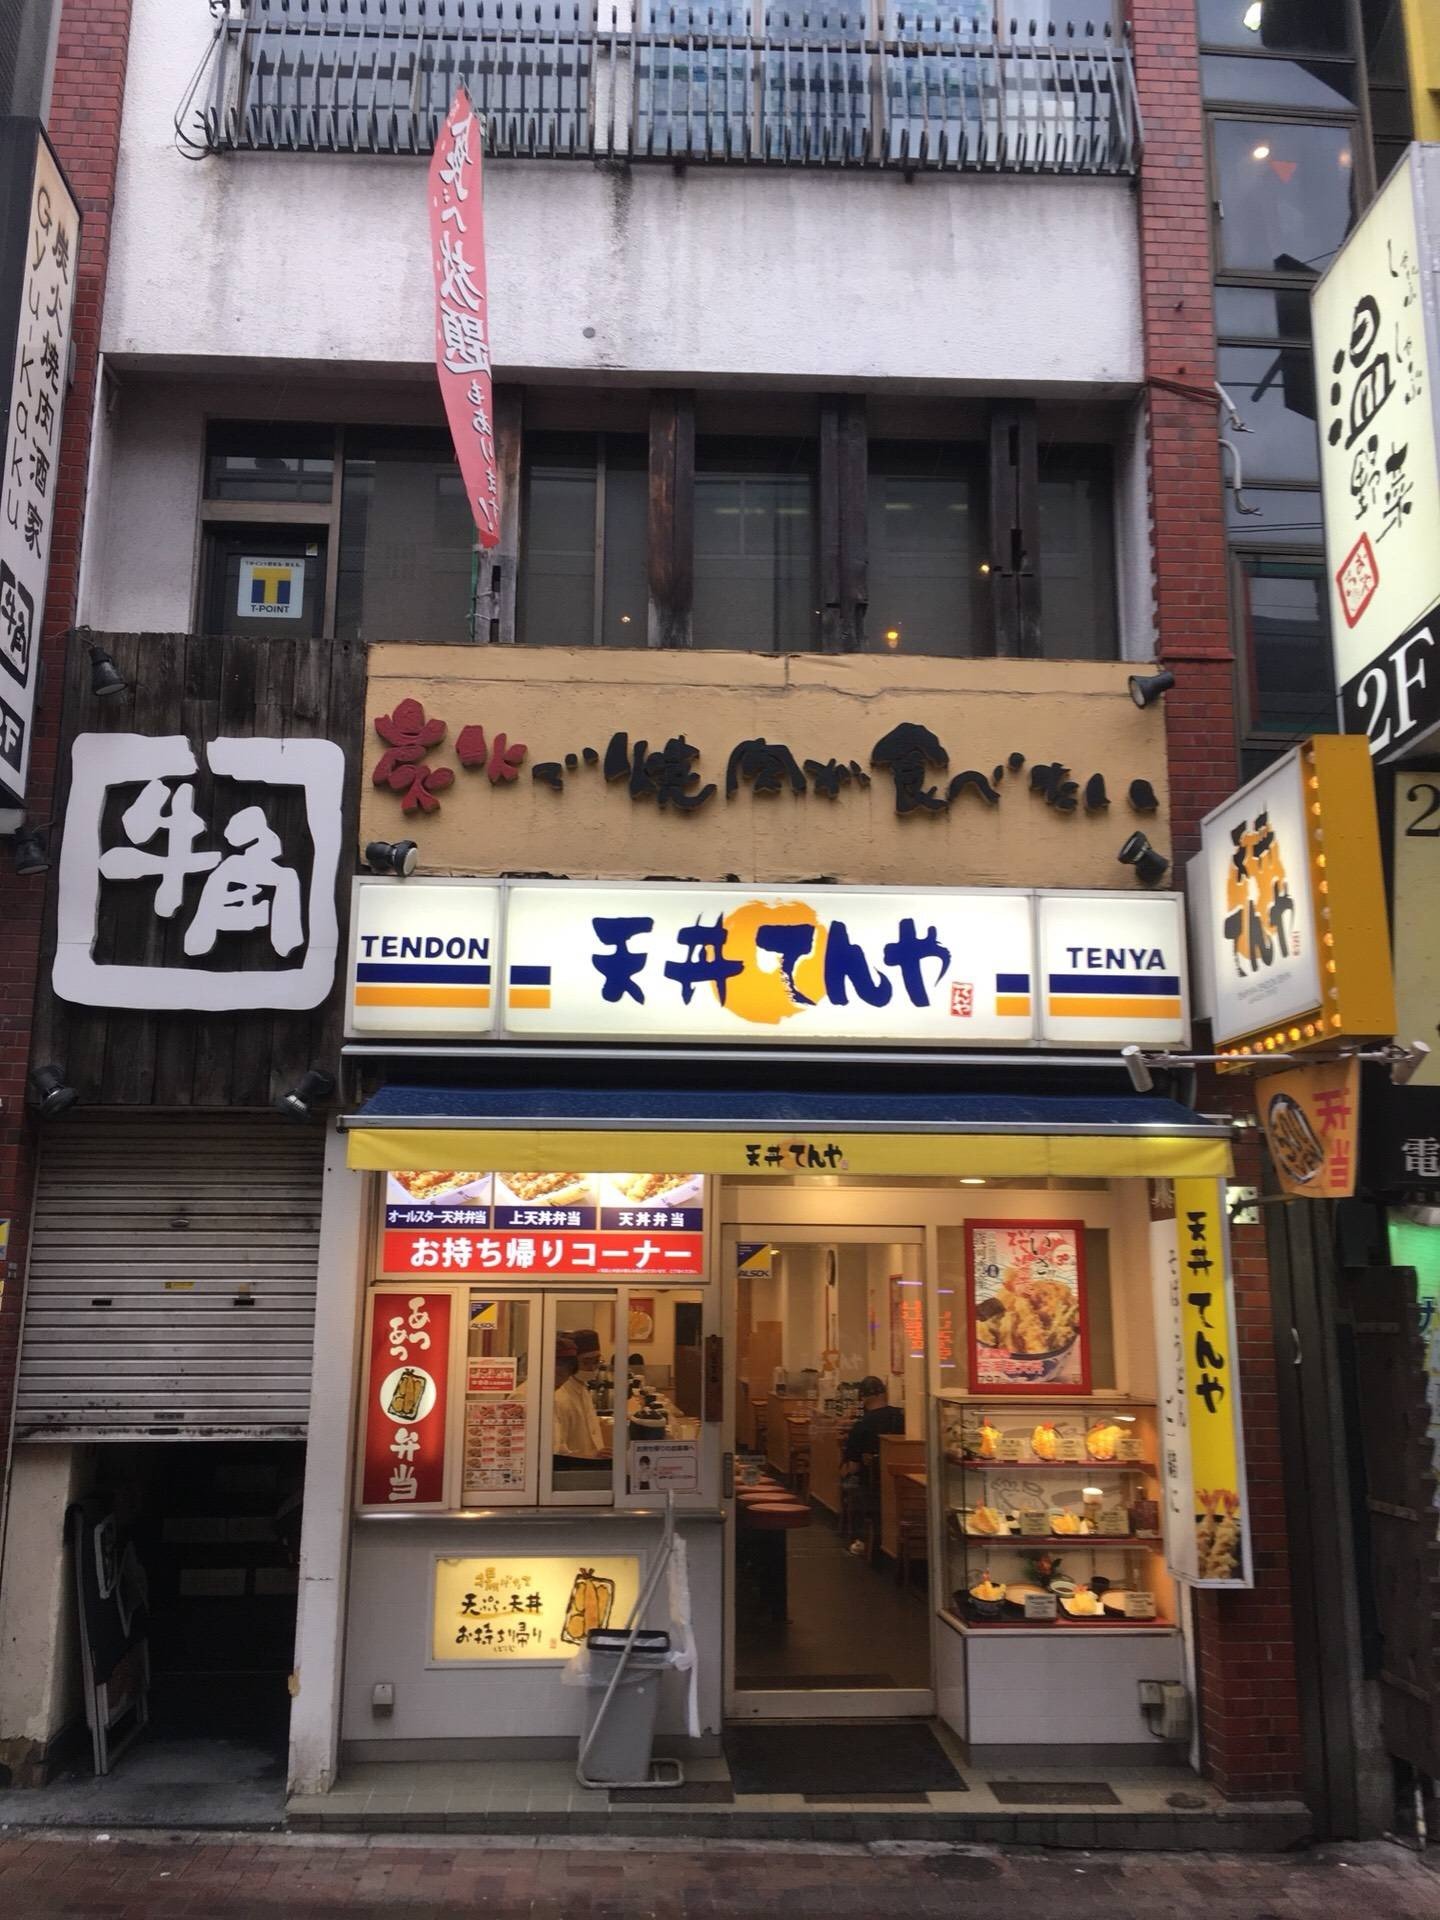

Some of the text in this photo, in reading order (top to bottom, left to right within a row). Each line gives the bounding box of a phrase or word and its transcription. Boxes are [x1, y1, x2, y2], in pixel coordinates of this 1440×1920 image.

[1329, 294, 1413, 544] 温野菜
[251, 604, 289, 613] T-POINT
[1357, 628, 1433, 752] 2F
[373, 697, 1159, 816] 炭火で焼肉が食べたい
[99, 778, 304, 957] 牛角
[361, 935, 490, 960] TENDON
[591, 911, 953, 1008] 天丼てんや
[1067, 946, 1166, 971] TENYA
[745, 1144, 843, 1168] 天丼てんや
[388, 1210, 487, 1224] オールスター天丼弁当
[510, 1210, 581, 1226] 上天丼弁当
[618, 1212, 685, 1227] 天丼弁当
[410, 1237, 692, 1269] お持ち帰りコーナー
[1186, 1211, 1225, 1414] 天丼てんや
[389, 1427, 421, 1501] 弁当
[456, 1622, 542, 1648] お持ち帰り
